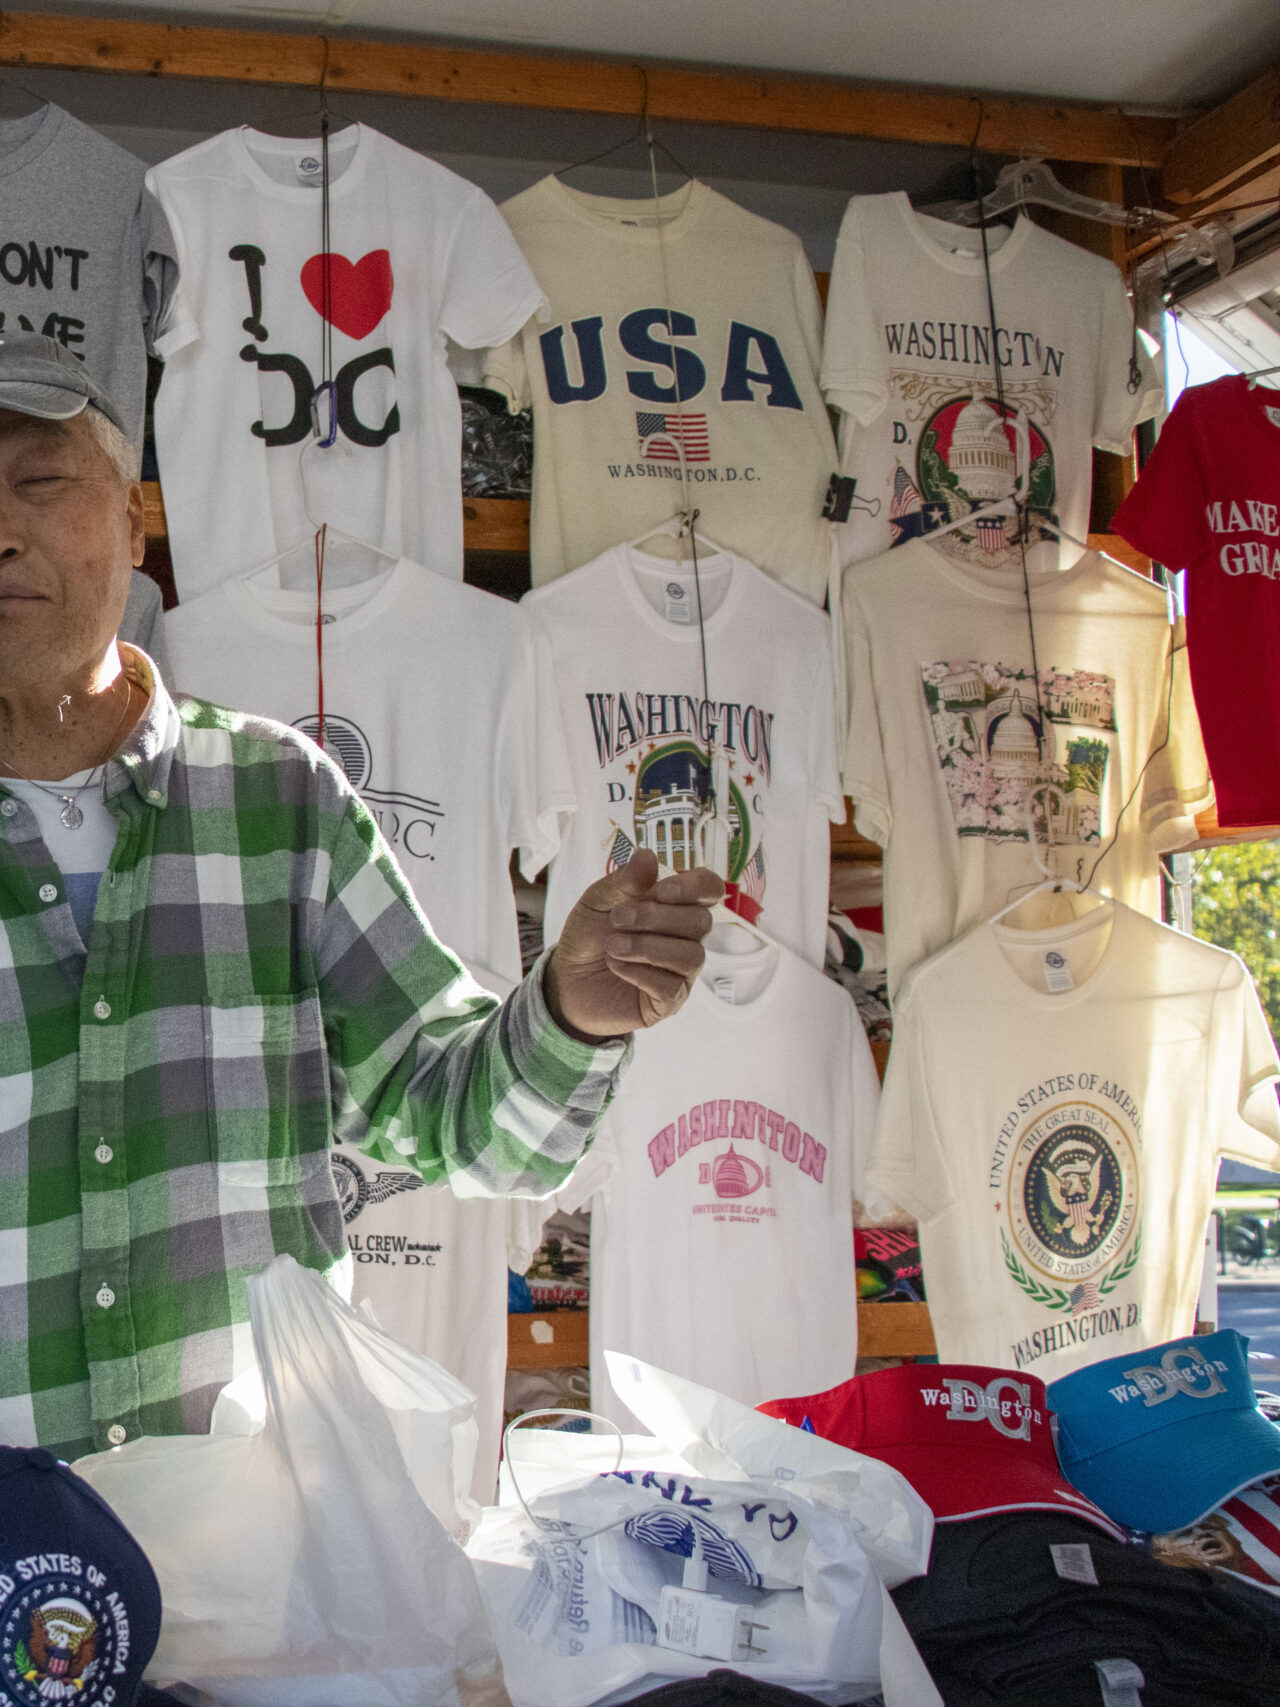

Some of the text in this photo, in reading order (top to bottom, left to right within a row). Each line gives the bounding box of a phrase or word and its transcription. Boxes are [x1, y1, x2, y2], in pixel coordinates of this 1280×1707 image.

[228, 244, 269, 342] I
[538, 307, 804, 412] USA
[239, 346, 401, 448] DC
[989, 1110, 1019, 1189] UNITED
[1018, 1073, 1075, 1115] STATES
[1078, 1072, 1100, 1091] OF
[1021, 1108, 1110, 1153] THE GREAT SEAL
[366, 1234, 408, 1252] CREW
[403, 1254, 437, 1266] D.C.
[1018, 1226, 1055, 1269] UNITED
[1055, 1259, 1092, 1275] STATES
[1101, 1203, 1134, 1262] AMERICA
[920, 1388, 1043, 1426] Washington
[941, 1377, 1032, 1443] DC
[1108, 1359, 1230, 1405] Washington
[1122, 1346, 1229, 1408] DC
[14, 1552, 84, 1582] STATES
[86, 1564, 108, 1589] OF
[103, 1591, 131, 1675] AMERICA
